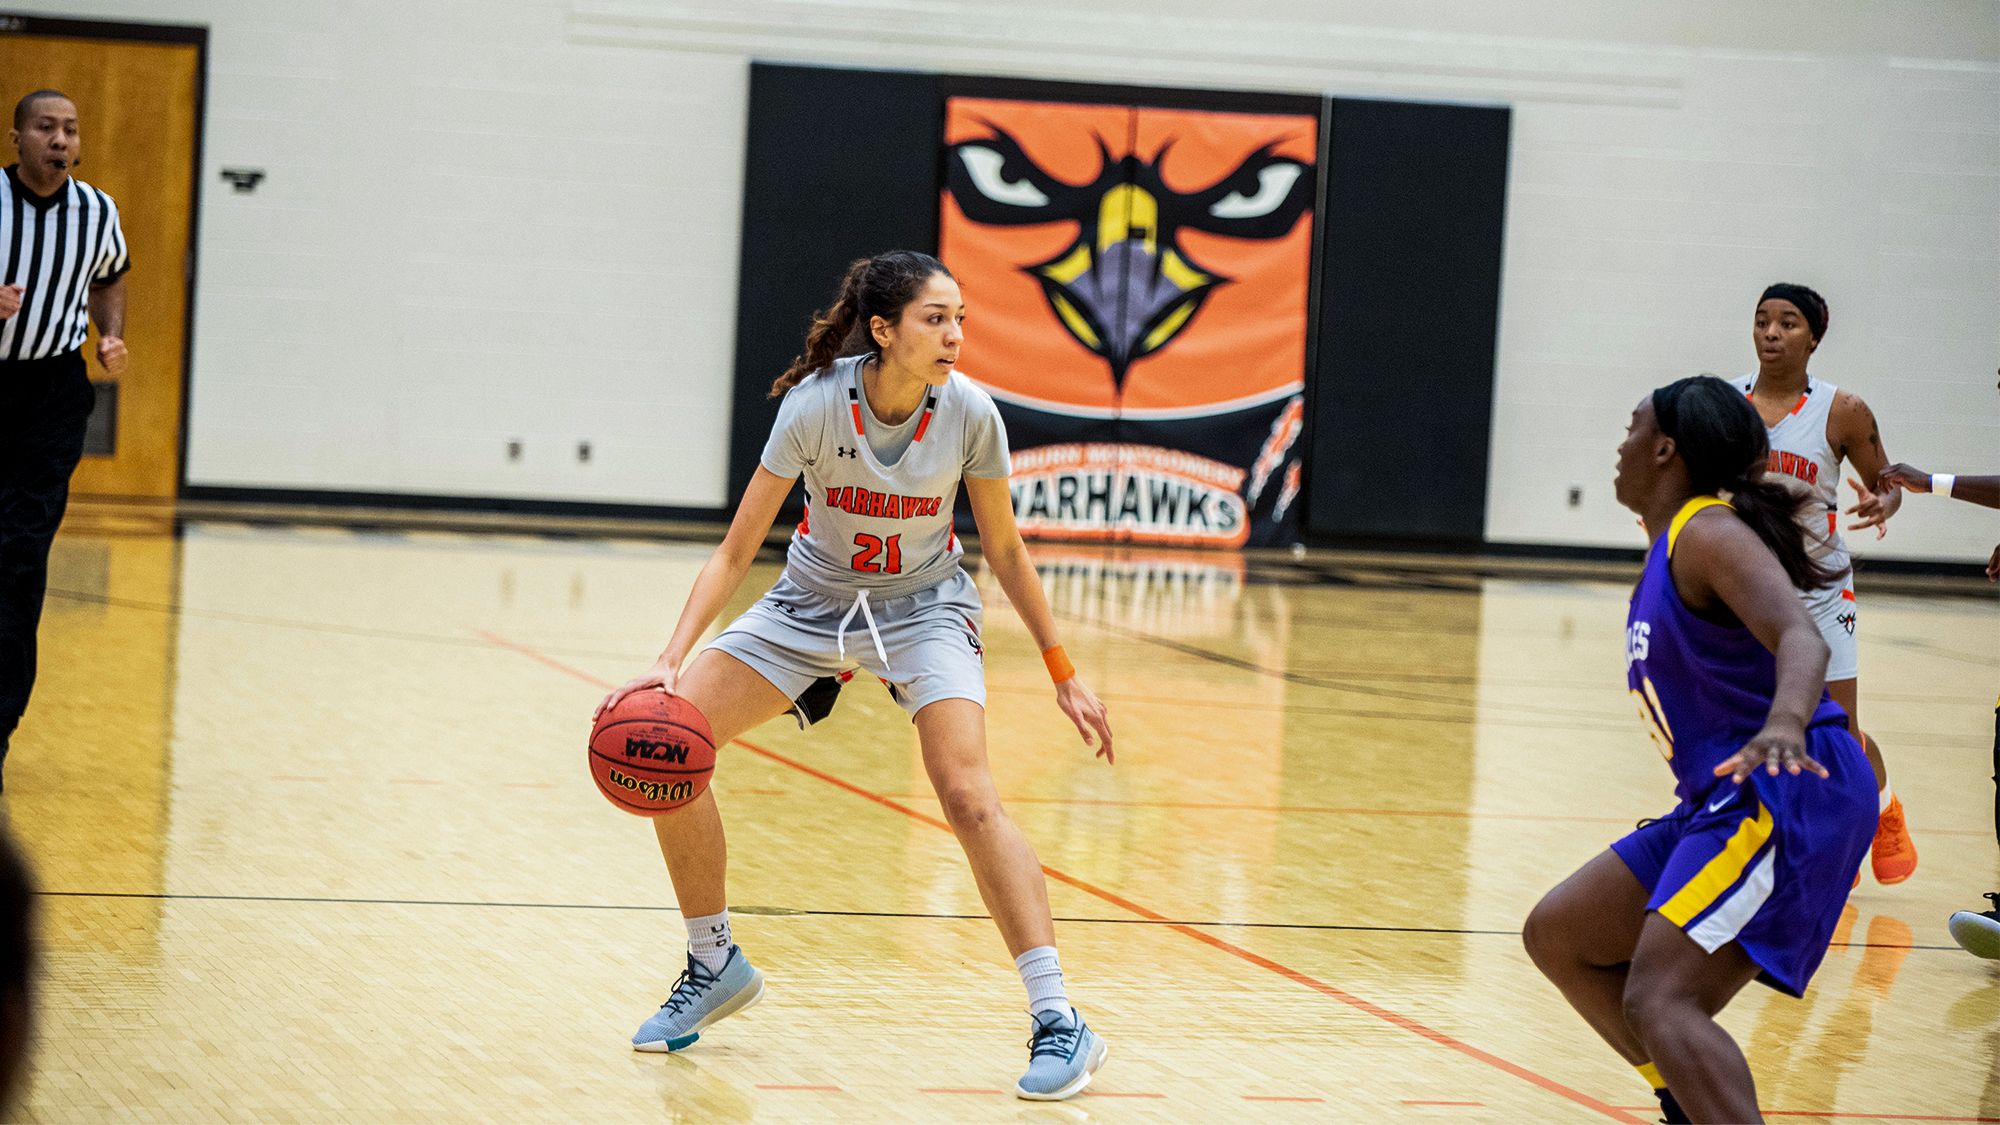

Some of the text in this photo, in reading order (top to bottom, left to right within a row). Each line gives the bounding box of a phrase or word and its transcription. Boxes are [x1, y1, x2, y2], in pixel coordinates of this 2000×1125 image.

[1766, 449, 1818, 485] AWKS
[825, 486, 942, 519] WARHAWKS
[851, 532, 902, 574] 21
[626, 738, 690, 764] NCAA
[609, 766, 694, 801] Wilson
